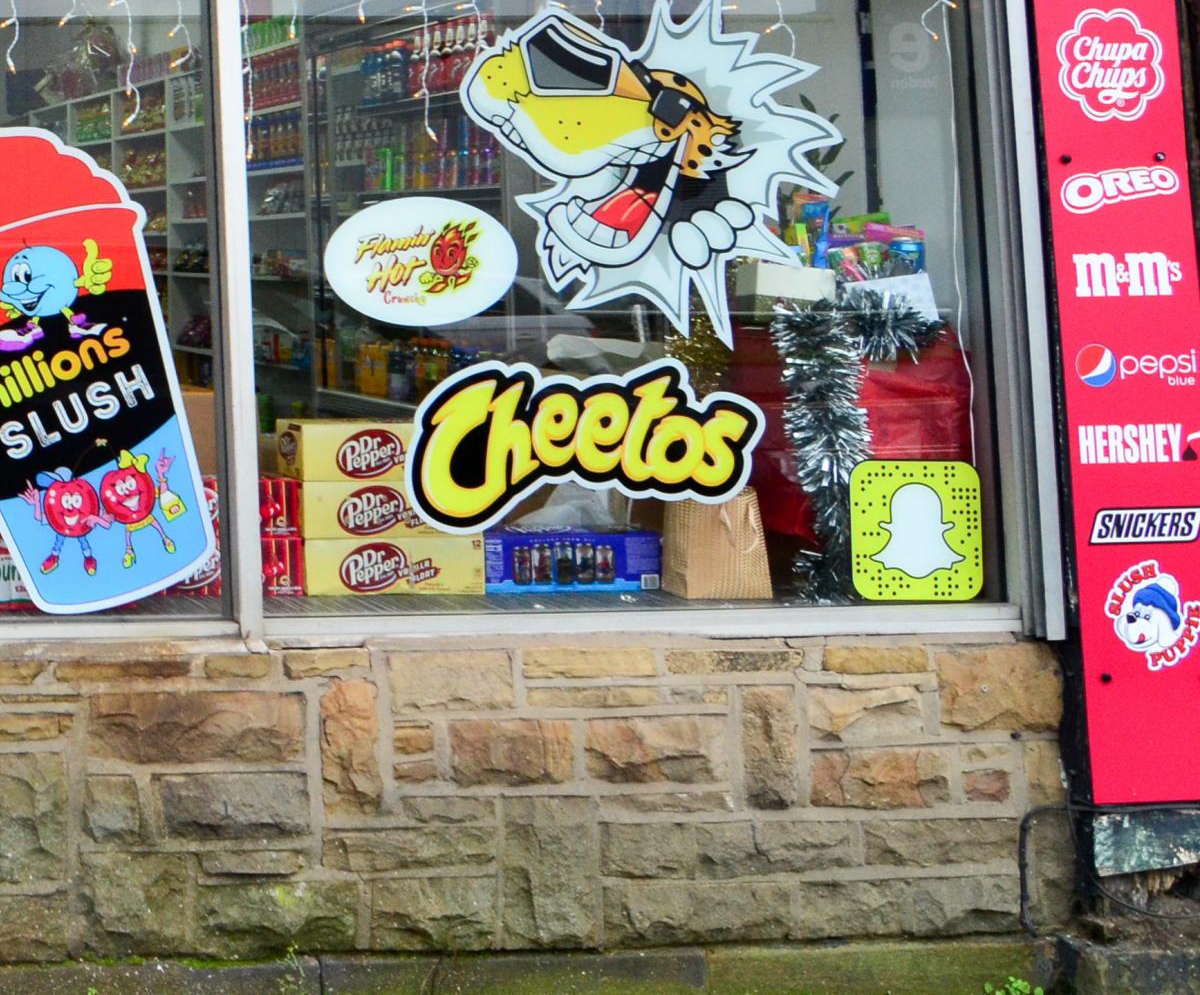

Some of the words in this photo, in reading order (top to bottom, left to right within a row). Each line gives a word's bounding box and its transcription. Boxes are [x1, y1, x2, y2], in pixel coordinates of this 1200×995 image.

[1072, 35, 1149, 68] Chupa
[1071, 61, 1148, 94] Chups
[1063, 168, 1176, 209] OREO
[1120, 349, 1197, 379] pepsi
[1168, 375, 1195, 386] blue
[341, 440, 397, 472] Pepper
[358, 435, 382, 454] Dr
[419, 374, 751, 520] Cheetos
[1078, 423, 1182, 465] HERSHEY
[343, 496, 400, 529] Pepper
[360, 491, 384, 511] Dr
[1097, 511, 1196, 539] SNICKERS
[343, 554, 400, 587] Pepper
[362, 549, 386, 568] Dr
[1108, 563, 1158, 616] SLUSH
